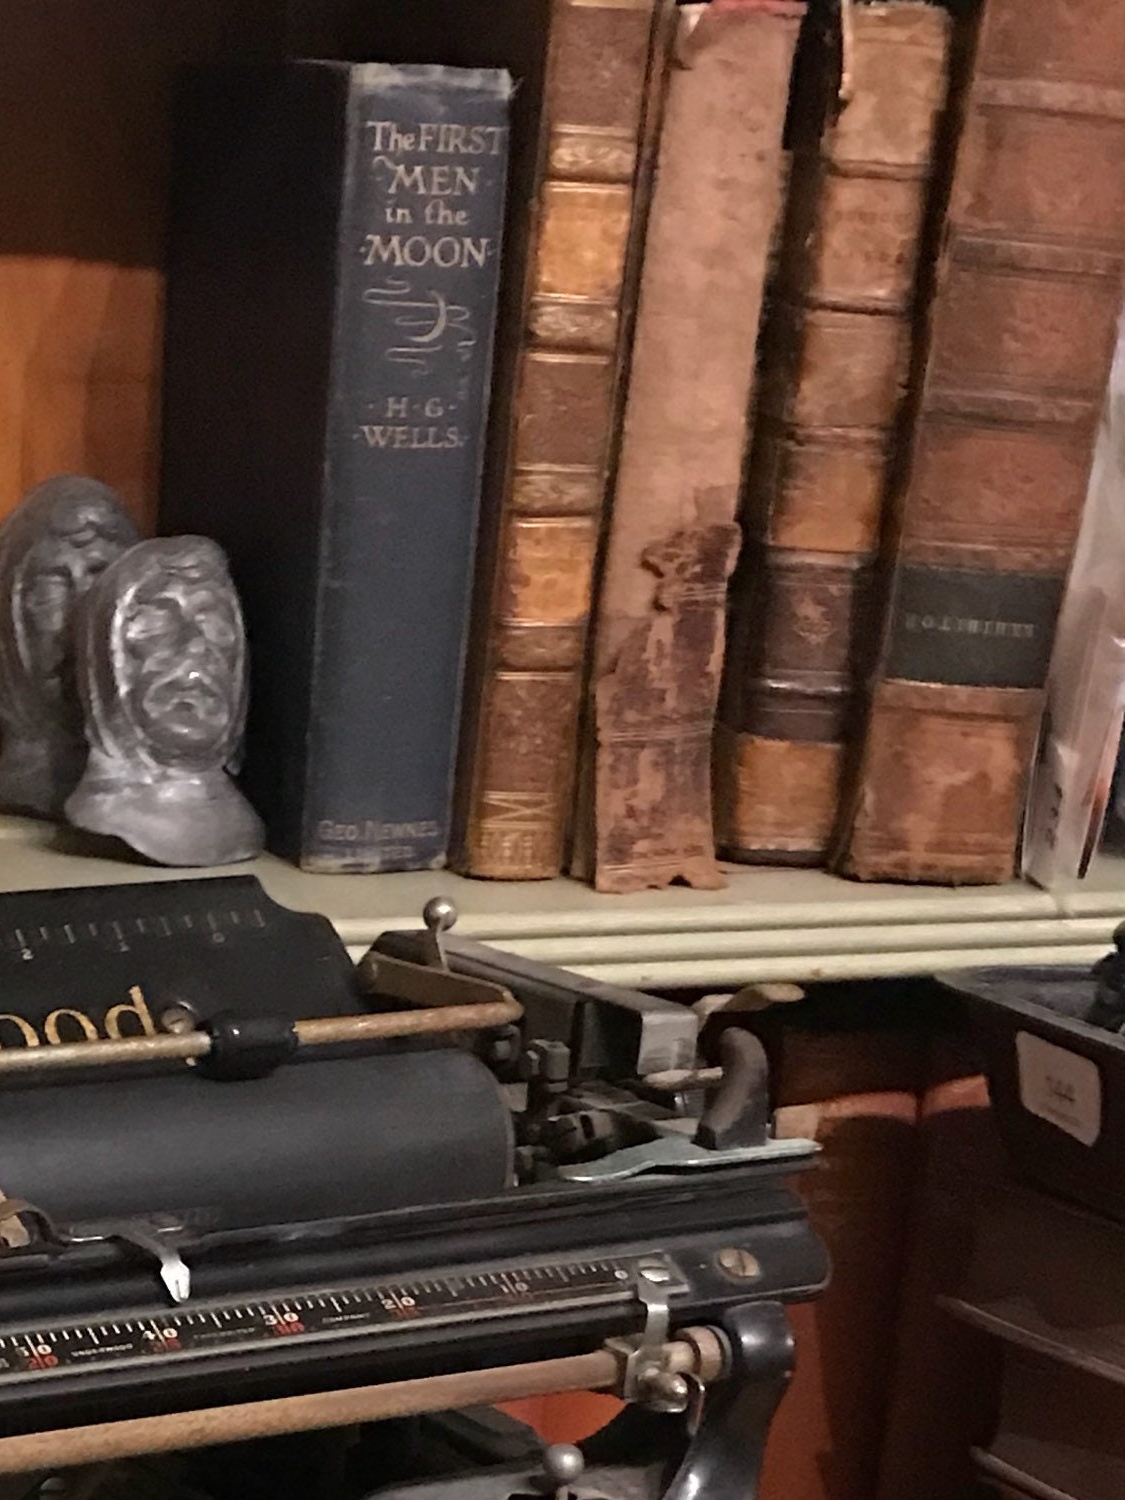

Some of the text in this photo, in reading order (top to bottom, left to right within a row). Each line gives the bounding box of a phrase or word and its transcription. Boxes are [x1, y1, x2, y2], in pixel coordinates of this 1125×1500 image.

[366, 121, 507, 156] The FIRST
[381, 160, 481, 195] MEN
[385, 200, 471, 226] in the
[363, 235, 488, 268] MOON
[361, 425, 463, 449] WELLS
[262, 1311, 300, 1327] 30
[381, 1296, 416, 1311] 20
